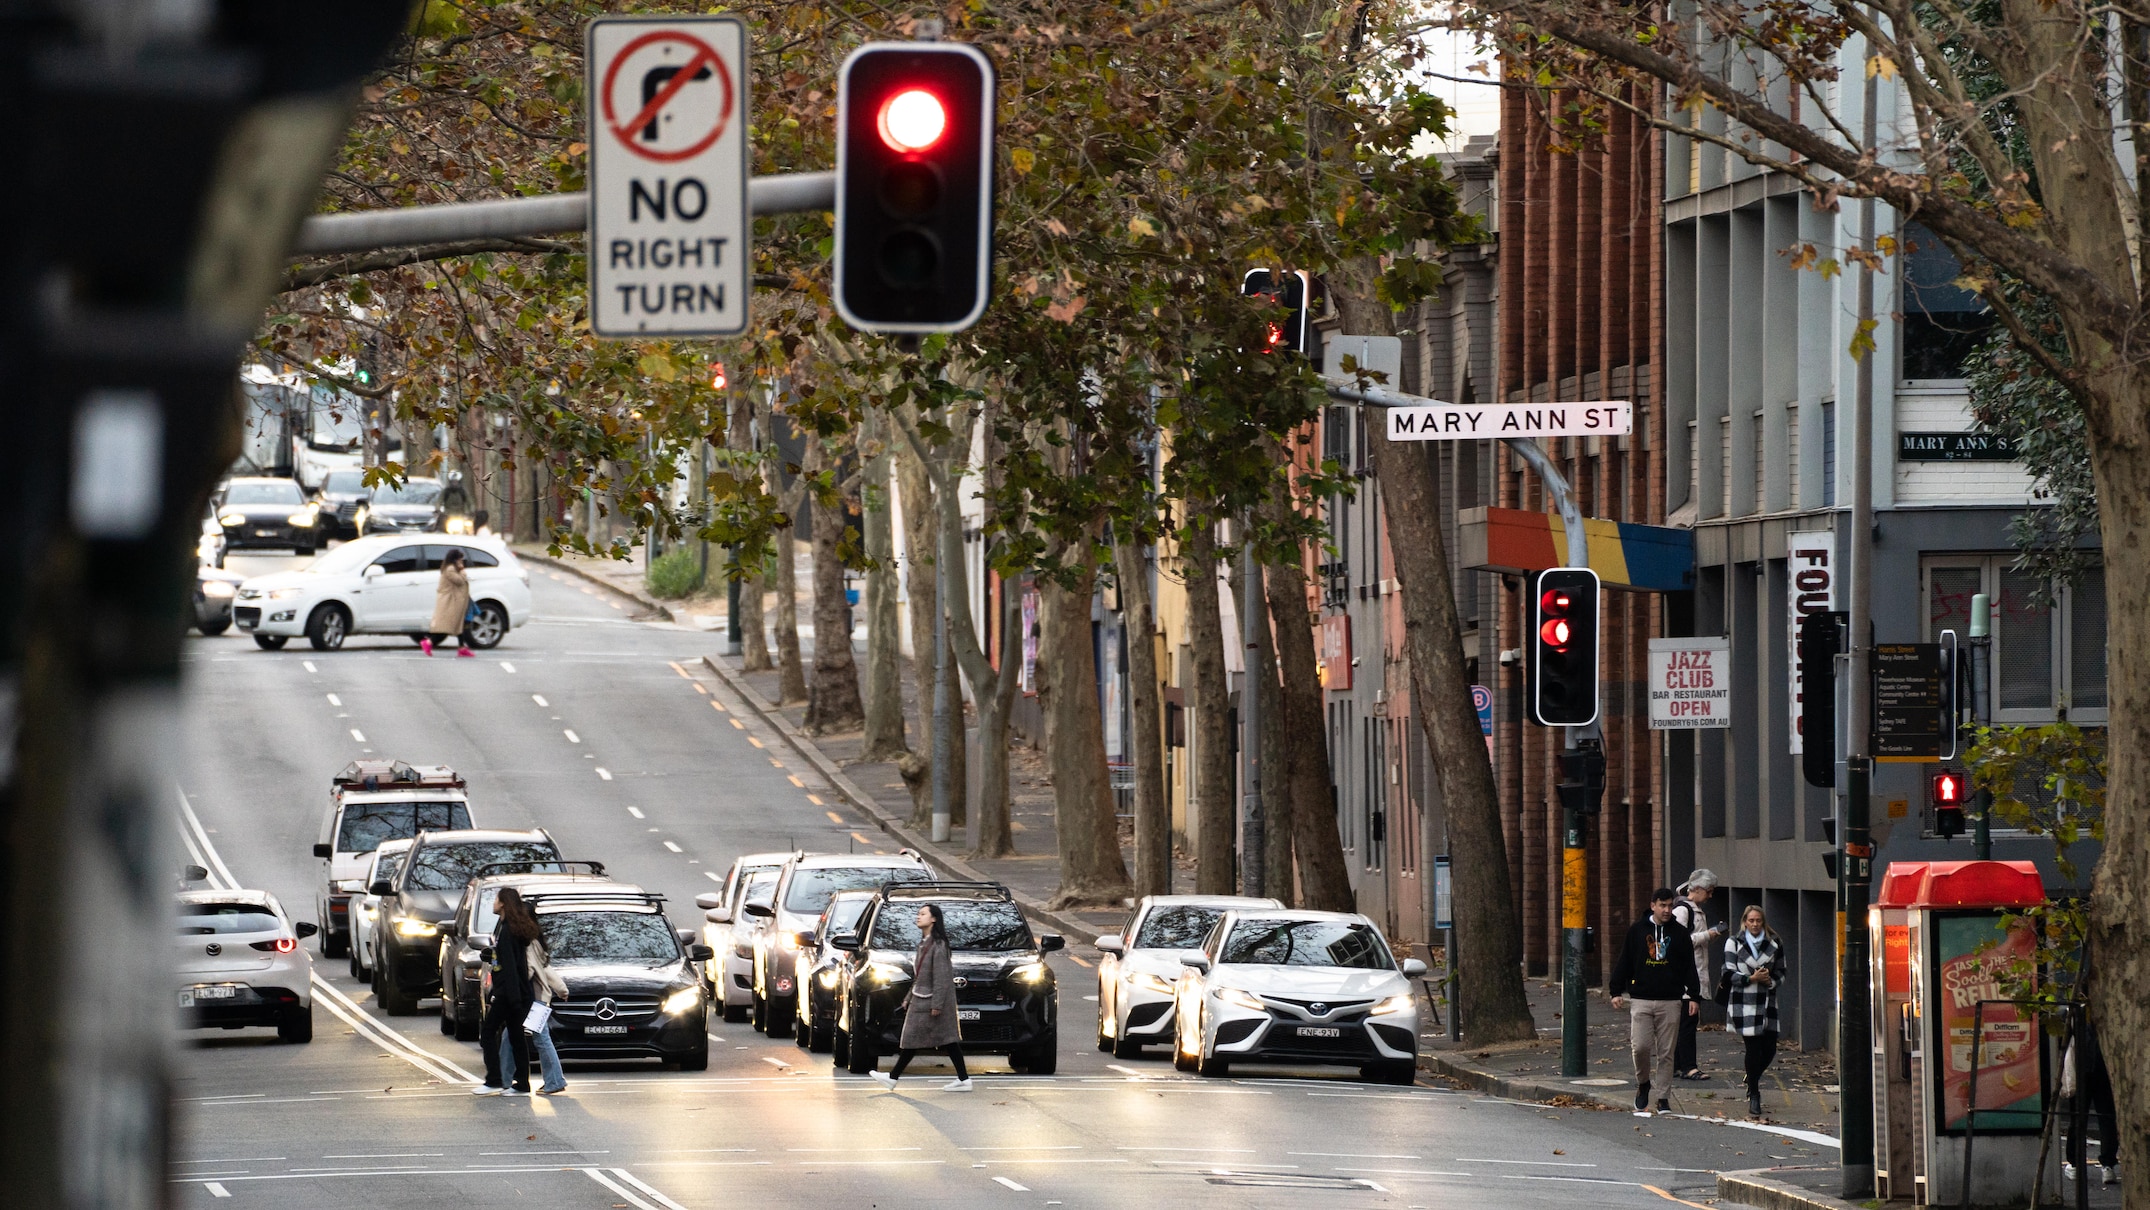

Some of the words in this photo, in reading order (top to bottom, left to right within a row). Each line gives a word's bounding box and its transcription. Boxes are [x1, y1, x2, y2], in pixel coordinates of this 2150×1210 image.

[630, 177, 709, 222] NO
[610, 237, 728, 270] RIGHT
[615, 284, 726, 314] TURN
[1395, 411, 1483, 433] MARY
[1501, 409, 1566, 431] ANN
[1584, 408, 1618, 429] ST
[1903, 436, 1947, 450] MARY
[1955, 437, 1988, 450] ANN
[1667, 650, 1711, 670] JAZZ
[1666, 670, 1714, 689] CLUB
[1474, 693, 1484, 707] B
[1652, 690, 1669, 700] BAR
[1674, 689, 1728, 699] RESTAURANT
[1670, 700, 1711, 716] OPEN
